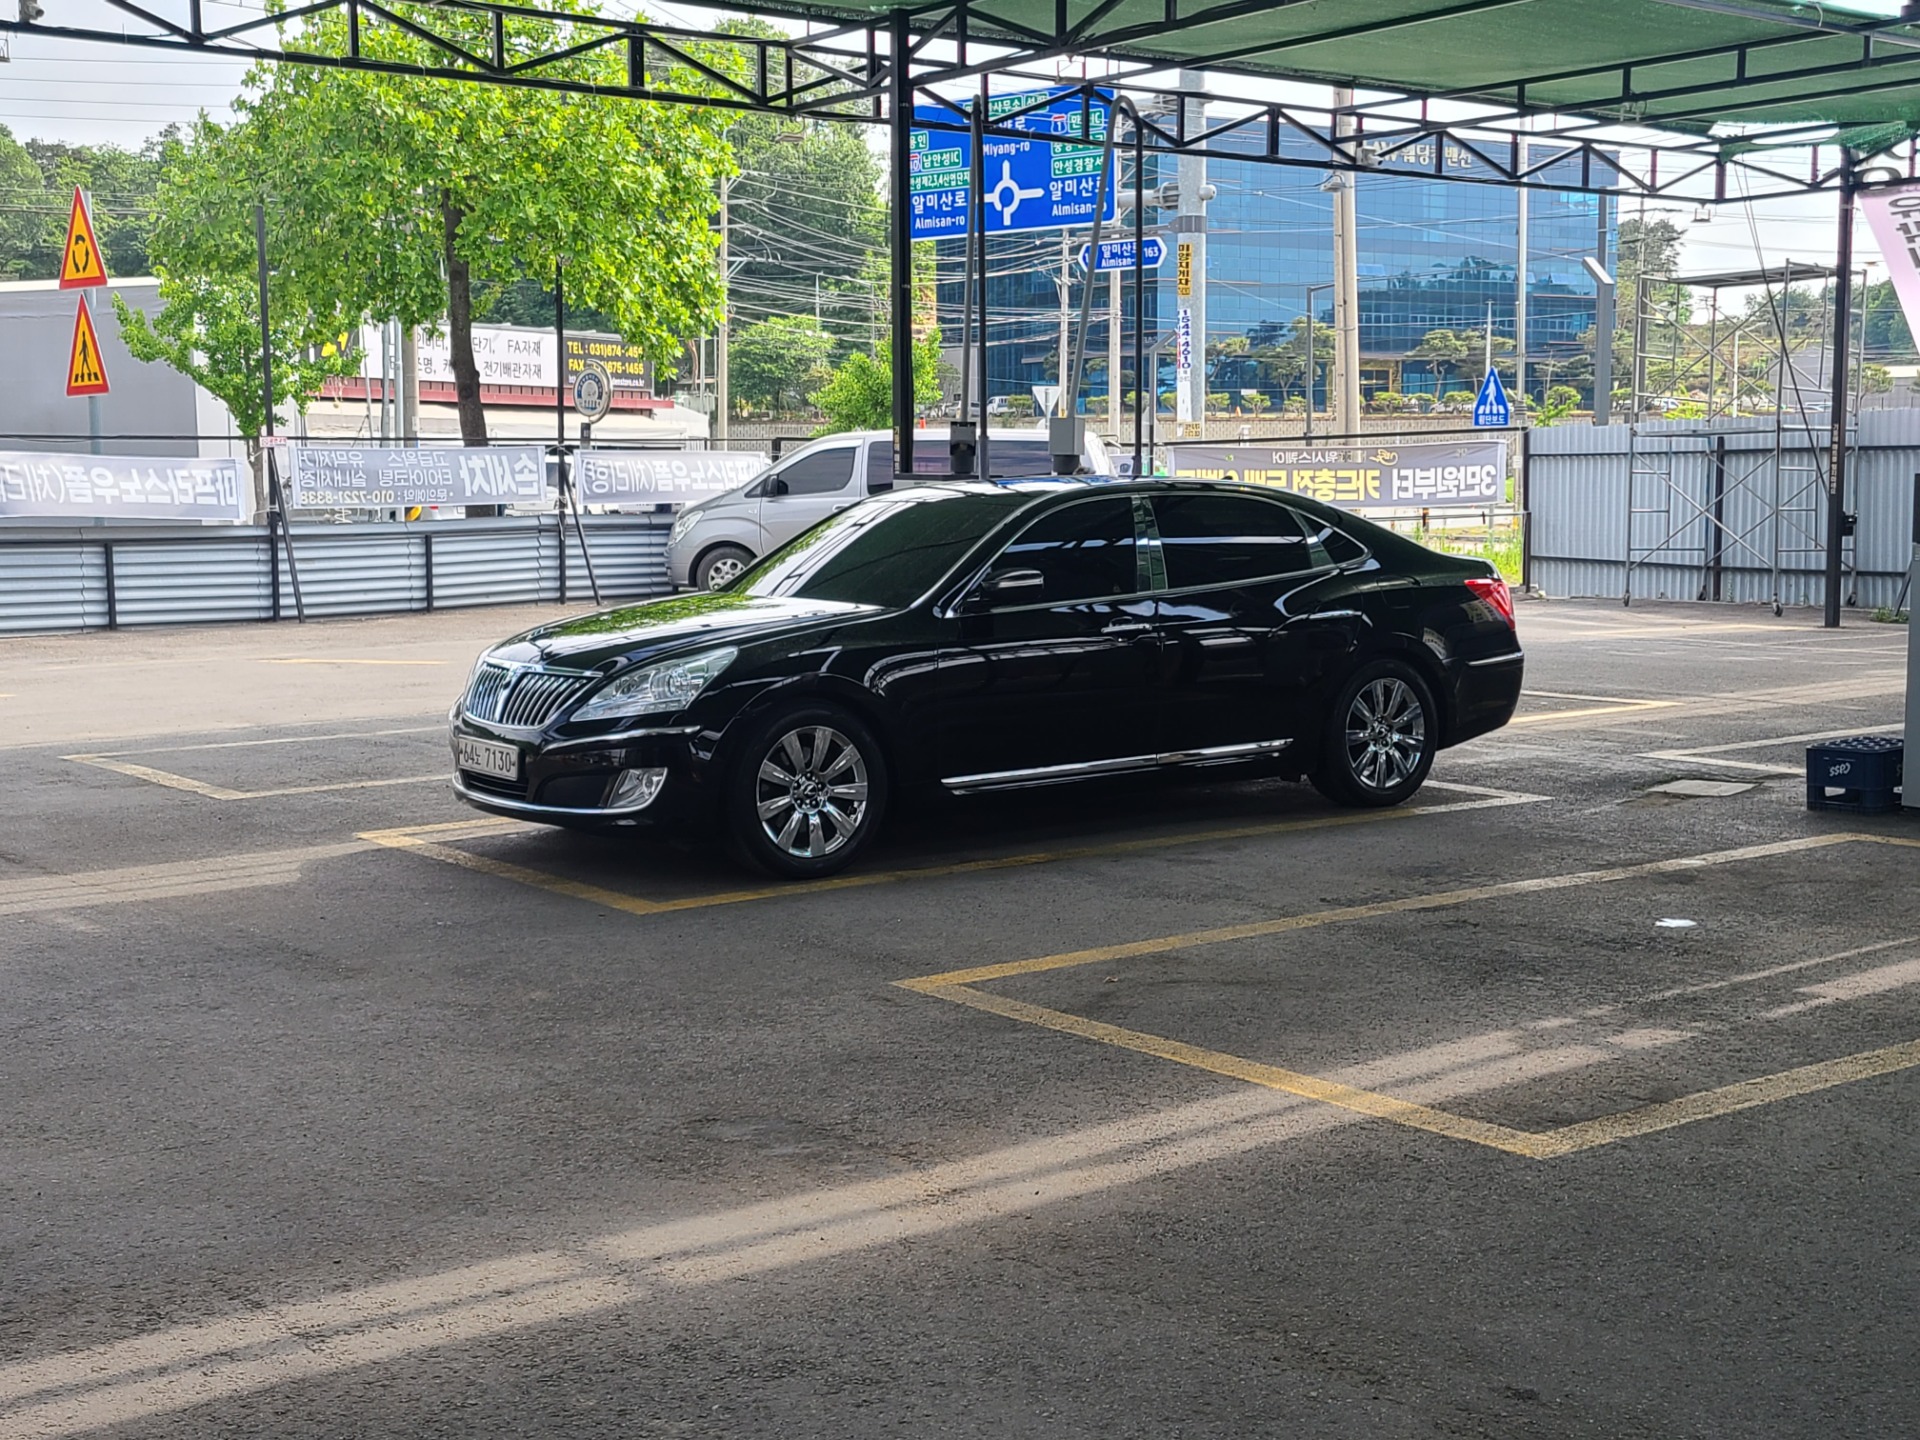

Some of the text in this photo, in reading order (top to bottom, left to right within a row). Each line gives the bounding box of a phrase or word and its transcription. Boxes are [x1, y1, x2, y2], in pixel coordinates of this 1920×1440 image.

[983, 142, 1030, 157] Miyang-ro
[923, 150, 960, 168] 남안성IC
[912, 190, 967, 215] 알미산로
[1052, 202, 1107, 217] Almisan-
[915, 215, 966, 230] Almisan-ro
[1143, 246, 1159, 258] 163
[1101, 257, 1136, 268] Almisan-
[507, 339, 541, 357] FA자재
[567, 341, 583, 355] TEL
[483, 361, 542, 379] 전기배관자재
[568, 359, 584, 371] FAX
[463, 742, 511, 773] 64노 7130
